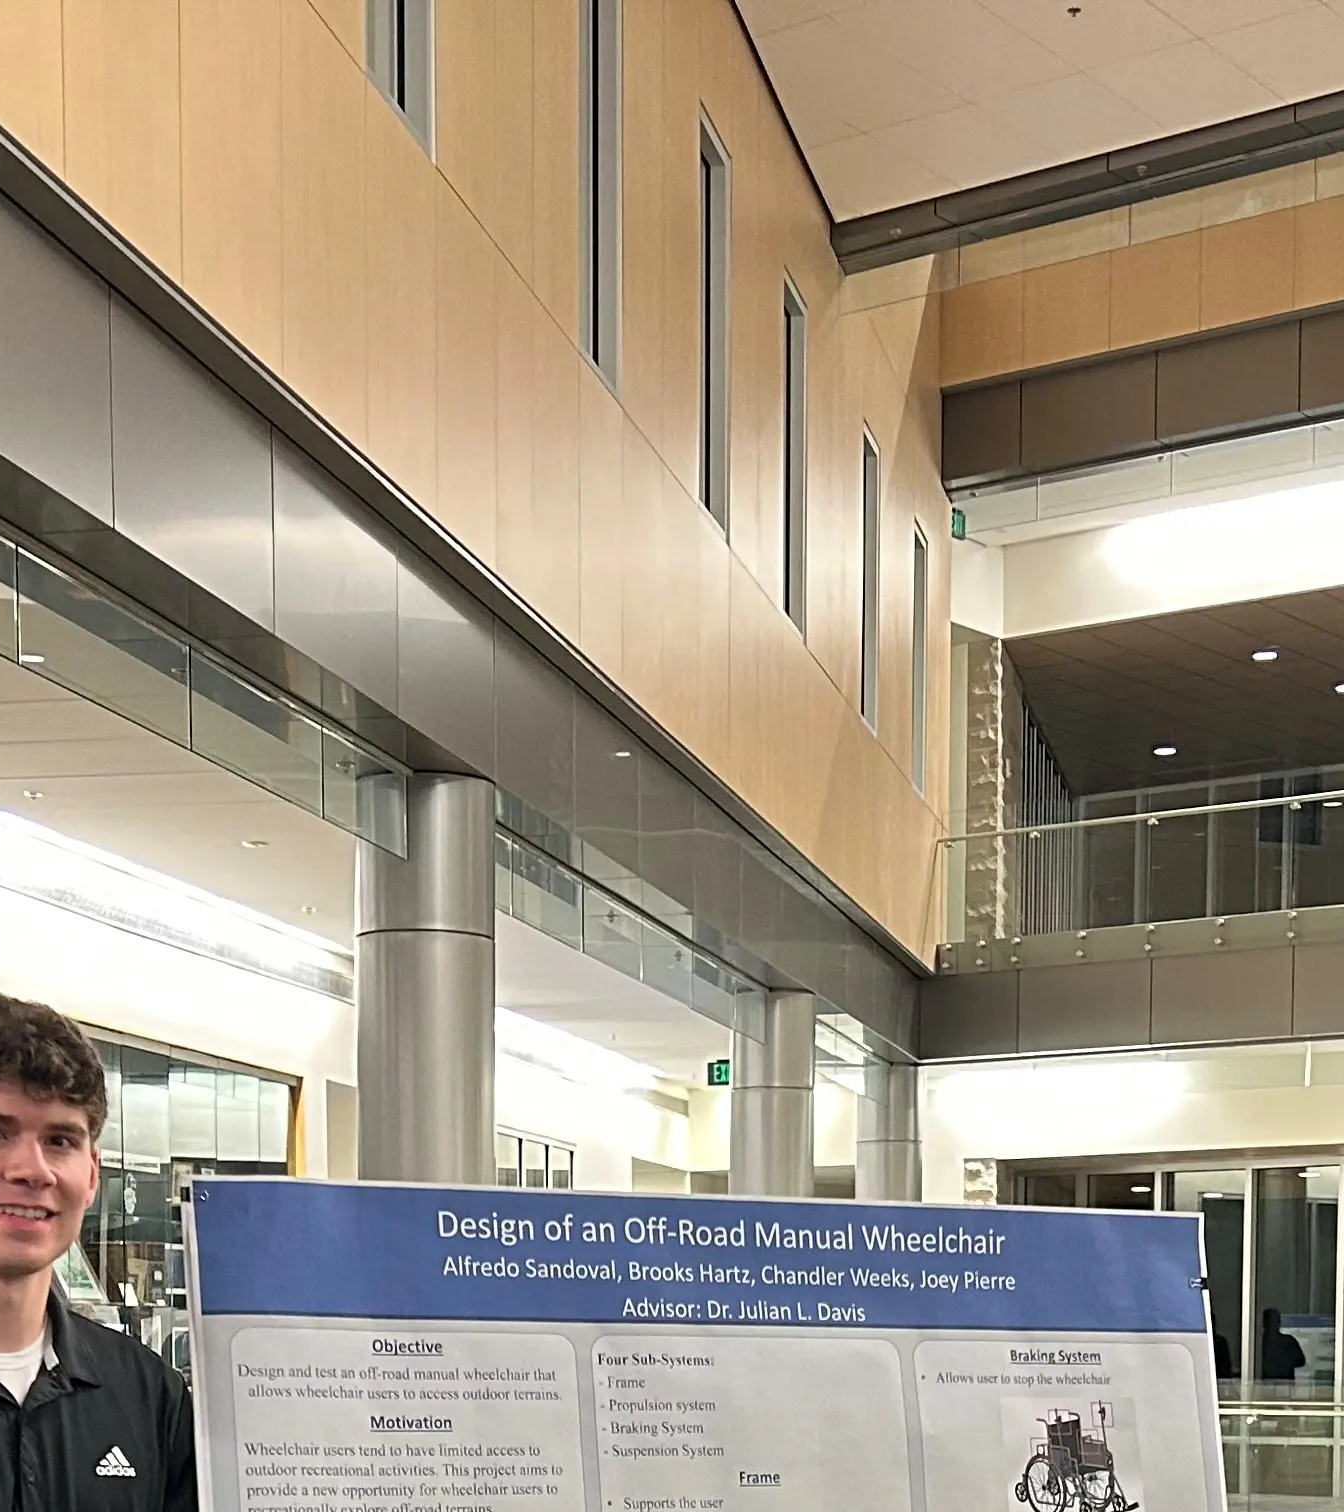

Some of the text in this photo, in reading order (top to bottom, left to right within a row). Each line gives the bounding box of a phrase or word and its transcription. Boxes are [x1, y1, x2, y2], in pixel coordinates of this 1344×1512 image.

[438, 1210, 1006, 1255] Design of an Off-Road Manual Wheelchair
[443, 1255, 1015, 1294] Alfredo Sandoval, Brooks Hartz, Chandler Weeks, Joey Pierre
[622, 1297, 866, 1322] Advisor: Dr. Julian L. Davis
[371, 1338, 443, 1356] Objective
[597, 1352, 715, 1369] Four Sub-Systems:
[1009, 1348, 1101, 1364] Braking System
[237, 1363, 556, 1382] Design and test an off-road manual wheelchair that
[936, 1371, 1111, 1389] Allows user to stop the wheelchair
[607, 1375, 646, 1389] Frame
[247, 1383, 561, 1401] allows wheelchair users to access outdoor terrains.
[609, 1398, 716, 1415] Propulsion system
[370, 1415, 452, 1431] Motivation
[610, 1420, 704, 1438] Braking System
[611, 1444, 724, 1461] Suspension System
[96, 1466, 136, 1477] adidas
[738, 1471, 780, 1487] Frame
[623, 1496, 726, 1512] Supports the user
